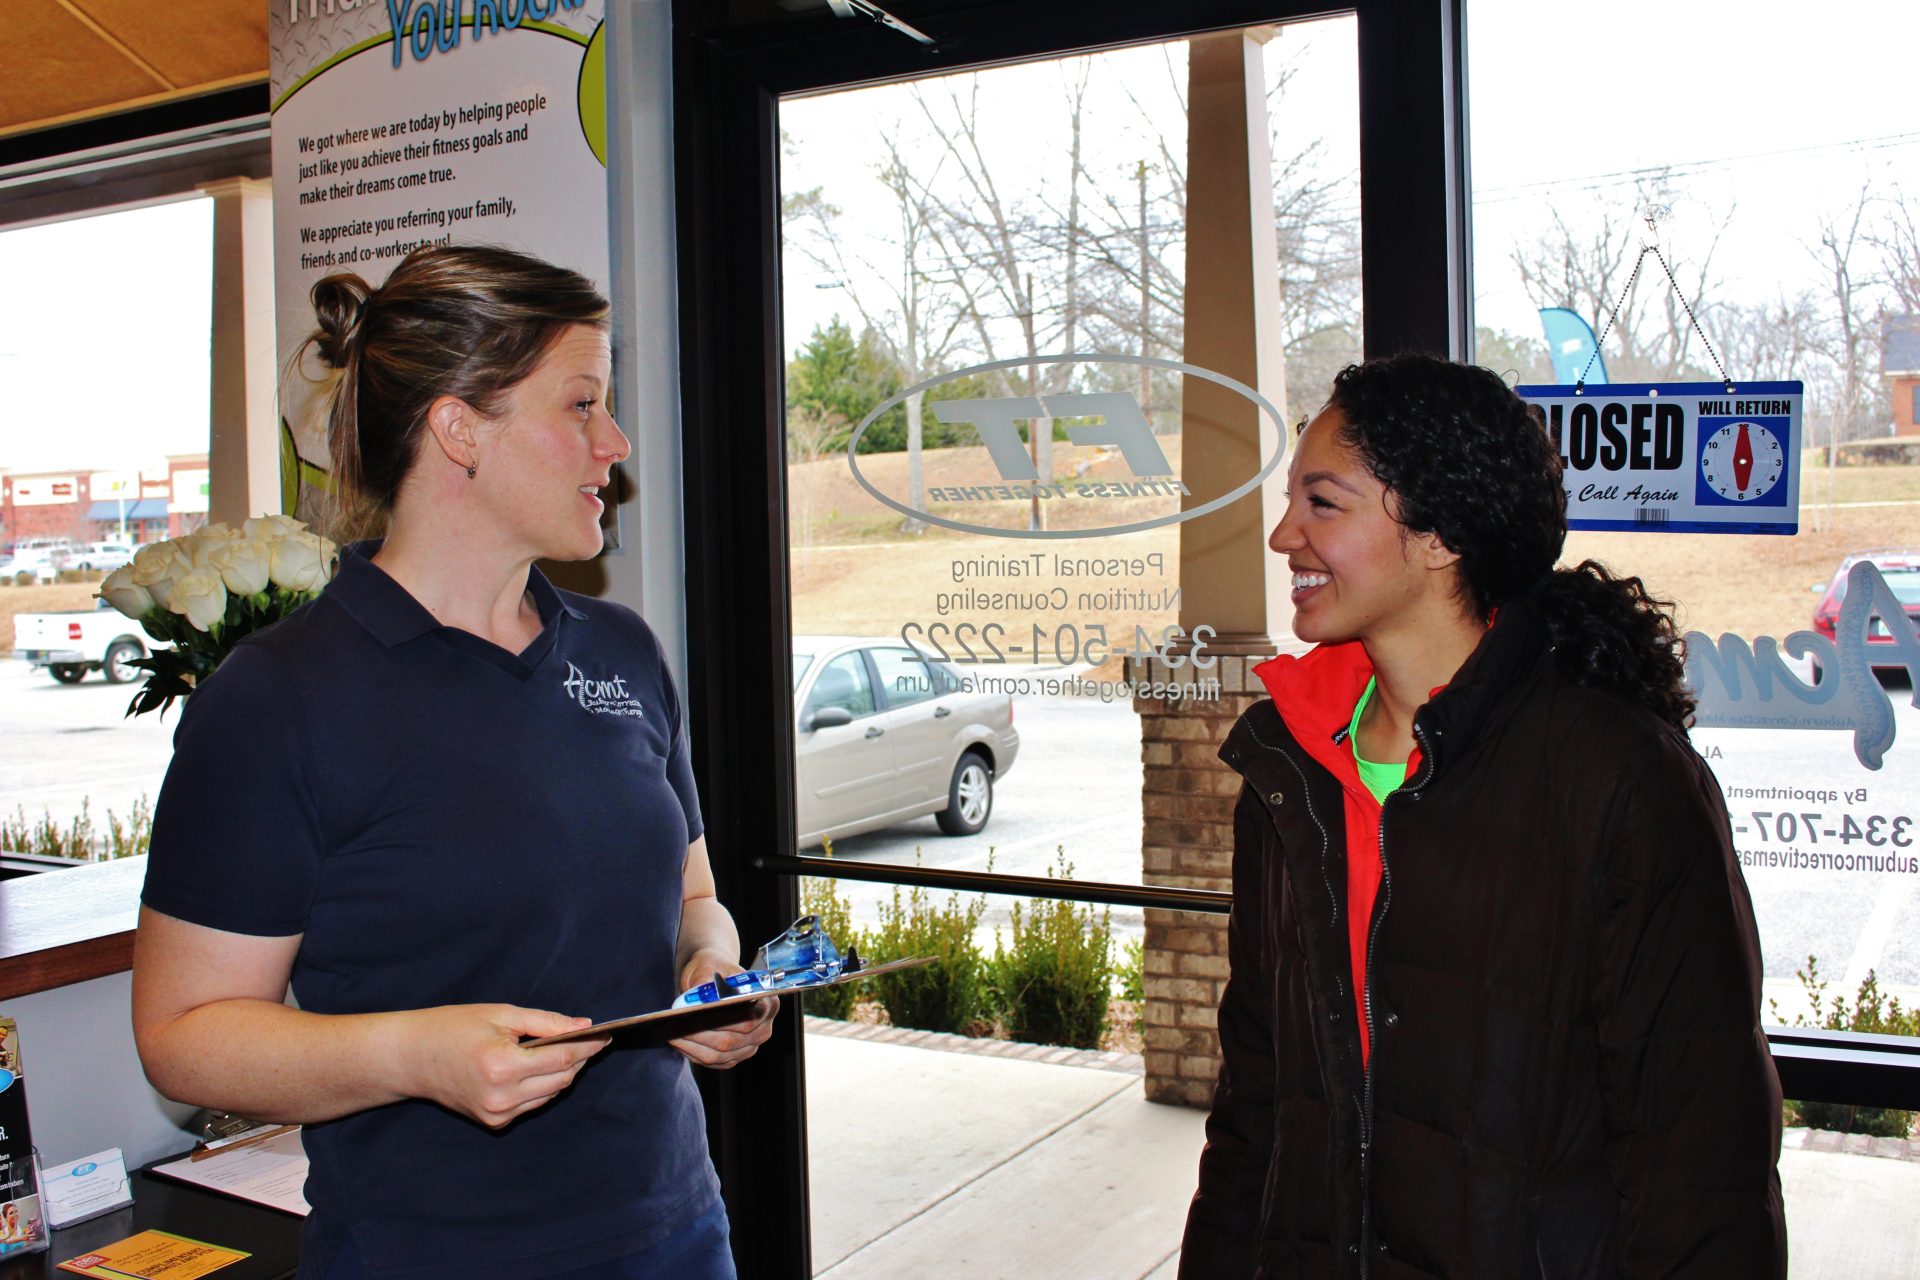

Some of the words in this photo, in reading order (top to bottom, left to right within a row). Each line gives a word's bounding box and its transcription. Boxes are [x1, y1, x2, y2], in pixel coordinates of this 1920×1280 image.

[387, 0, 460, 69] You
[299, 137, 315, 153] We
[317, 133, 334, 154] got
[336, 129, 369, 146] where
[371, 126, 387, 140] we
[389, 121, 406, 136] are
[409, 114, 440, 133] today
[443, 110, 456, 130] by
[459, 102, 502, 124] helping
[506, 93, 546, 120] people
[299, 163, 318, 184] just
[320, 158, 338, 175] like
[340, 157, 359, 176] you
[361, 149, 401, 168] achieve
[404, 141, 430, 160] their
[432, 138, 469, 156] fitness
[472, 128, 503, 153] goals
[506, 123, 528, 143] and
[300, 186, 327, 205] make
[329, 181, 354, 200] their
[356, 179, 395, 196] dreams
[397, 172, 426, 189] come
[428, 168, 456, 184] true.
[301, 227, 316, 243] We
[318, 219, 373, 244] appreciate
[375, 218, 394, 237] you
[397, 208, 445, 228] referring
[448, 206, 473, 226] your
[475, 196, 516, 218] family,
[301, 249, 336, 270] friends
[338, 246, 357, 264] and
[360, 239, 417, 261] co-workers
[1698, 400, 1732, 415] WILL
[1735, 400, 1791, 415] RETURN
[1528, 403, 1684, 471] LOSED
[1721, 428, 1730, 436] 11
[1760, 428, 1765, 436] 1
[1707, 474, 1713, 482] 8
[1755, 488, 1762, 496] 5
[1579, 483, 1619, 501] Call
[1623, 484, 1679, 505] Again
